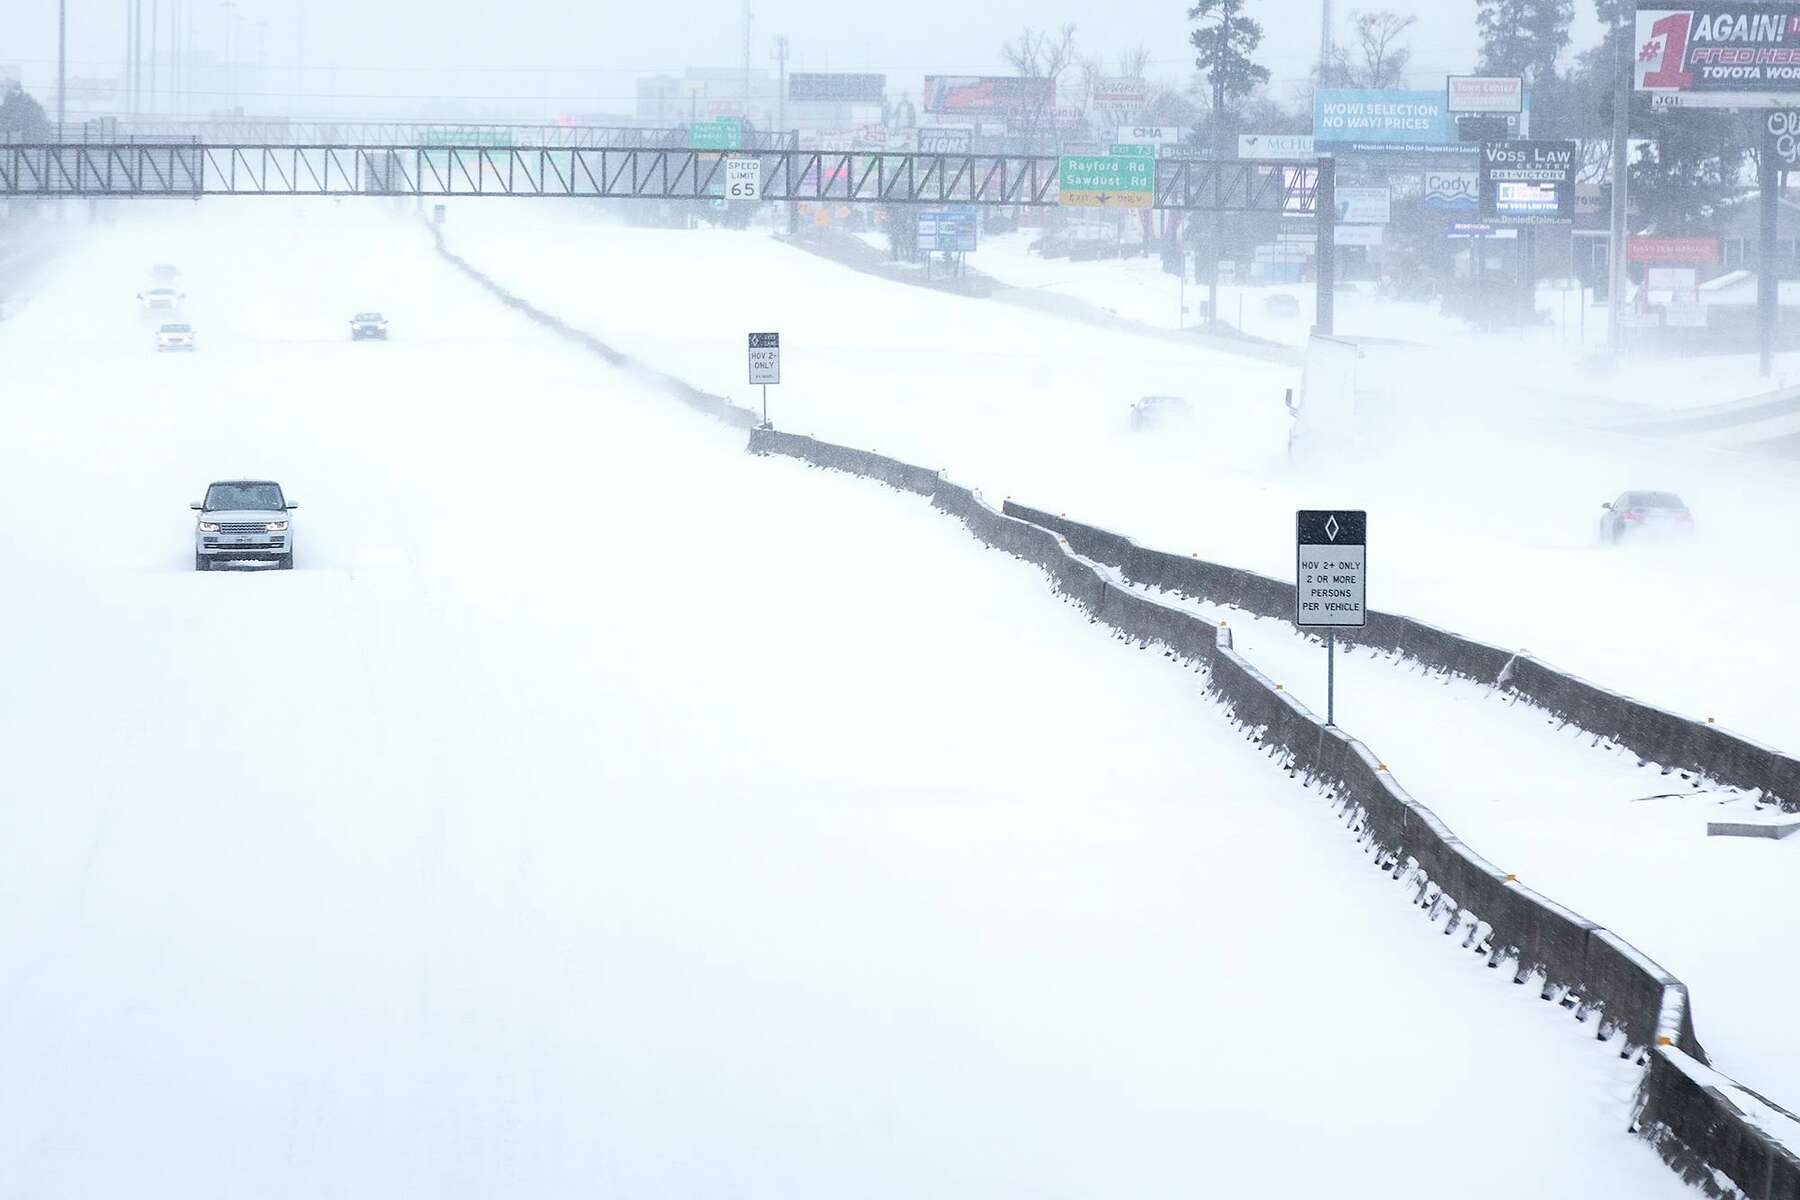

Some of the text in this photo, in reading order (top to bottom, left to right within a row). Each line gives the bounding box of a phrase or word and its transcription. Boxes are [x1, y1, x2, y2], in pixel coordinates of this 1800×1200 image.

[1694, 14, 1787, 42] AGAIN!
[1703, 67, 1761, 79] TOYOTA
[1323, 103, 1439, 117] WOW! SELECTION
[1323, 116, 1430, 130] NO WAY! PRICES
[1767, 112, 1800, 136] Ol
[728, 161, 759, 170] SPEED
[1069, 160, 1145, 172] Rayford Rd
[731, 172, 754, 180] LIMIT
[1066, 175, 1147, 186] Sawdust Rd
[731, 183, 756, 196] 65
[1428, 175, 1471, 193] Cody
[751, 352, 766, 360] HOV
[754, 361, 775, 369] ONLY
[1301, 561, 1361, 570] HOV 2+ ONLY
[1306, 575, 1357, 584] 2 OR MORE
[1311, 589, 1352, 598] PERSONS
[1302, 602, 1360, 612] PER VEHICLE
